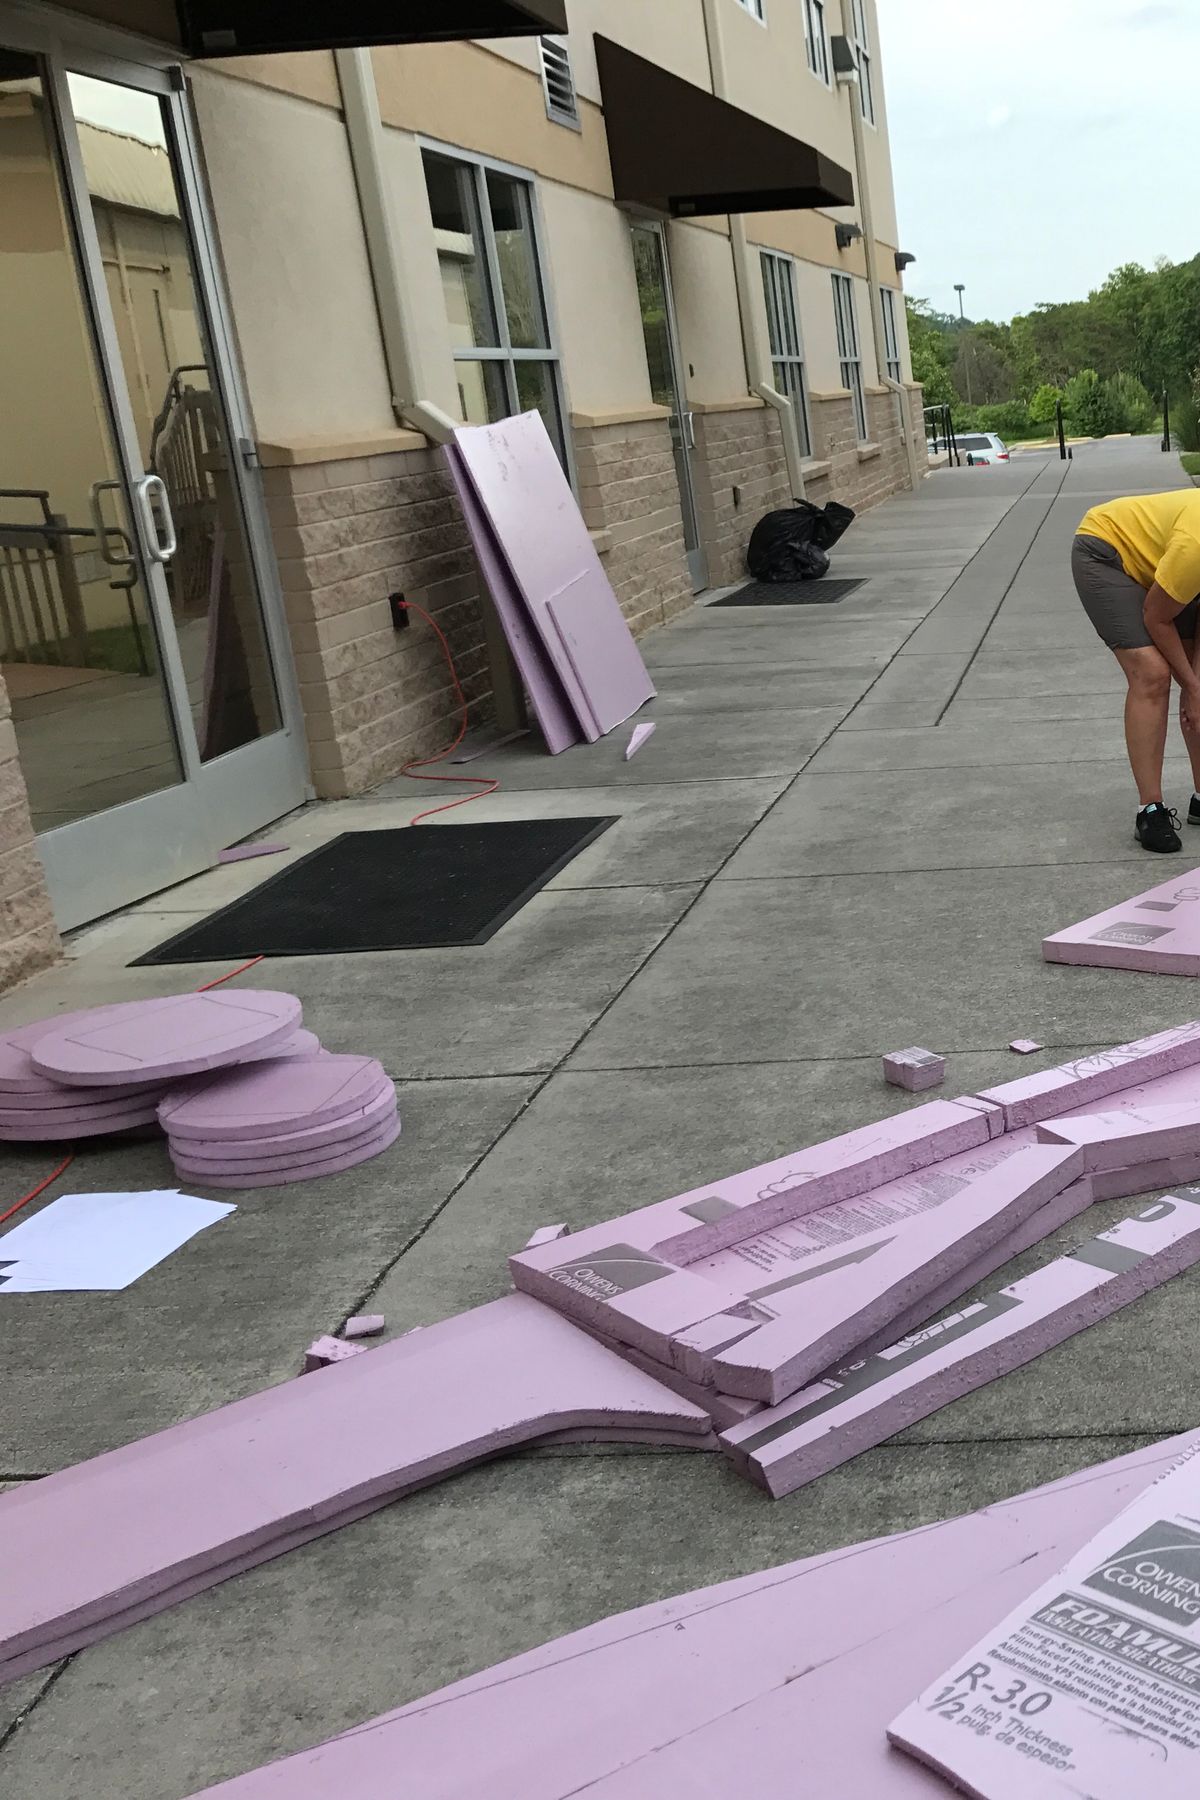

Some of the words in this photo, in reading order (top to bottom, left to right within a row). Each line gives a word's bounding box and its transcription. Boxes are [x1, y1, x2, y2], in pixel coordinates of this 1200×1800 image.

[574, 1267, 624, 1294] OWENS
[1037, 1610, 1121, 1650] INSULATING
[952, 1661, 1053, 1717] R-3.0
[1008, 1633, 1068, 1663] Film-Faced
[1069, 1658, 1123, 1690] Insulating
[1123, 1682, 1181, 1716] Sheathing
[1182, 1708, 1200, 1722] for
[1052, 1663, 1073, 1679] XPS
[1073, 1673, 1120, 1700] resistente
[1137, 1703, 1185, 1729] humedad
[1004, 1716, 1074, 1758] Thickness
[1088, 1695, 1108, 1708] con
[1143, 1721, 1169, 1737] para
[956, 1713, 992, 1737] pulg.
[995, 1730, 1015, 1746] de
[1015, 1741, 1077, 1773] espesor
